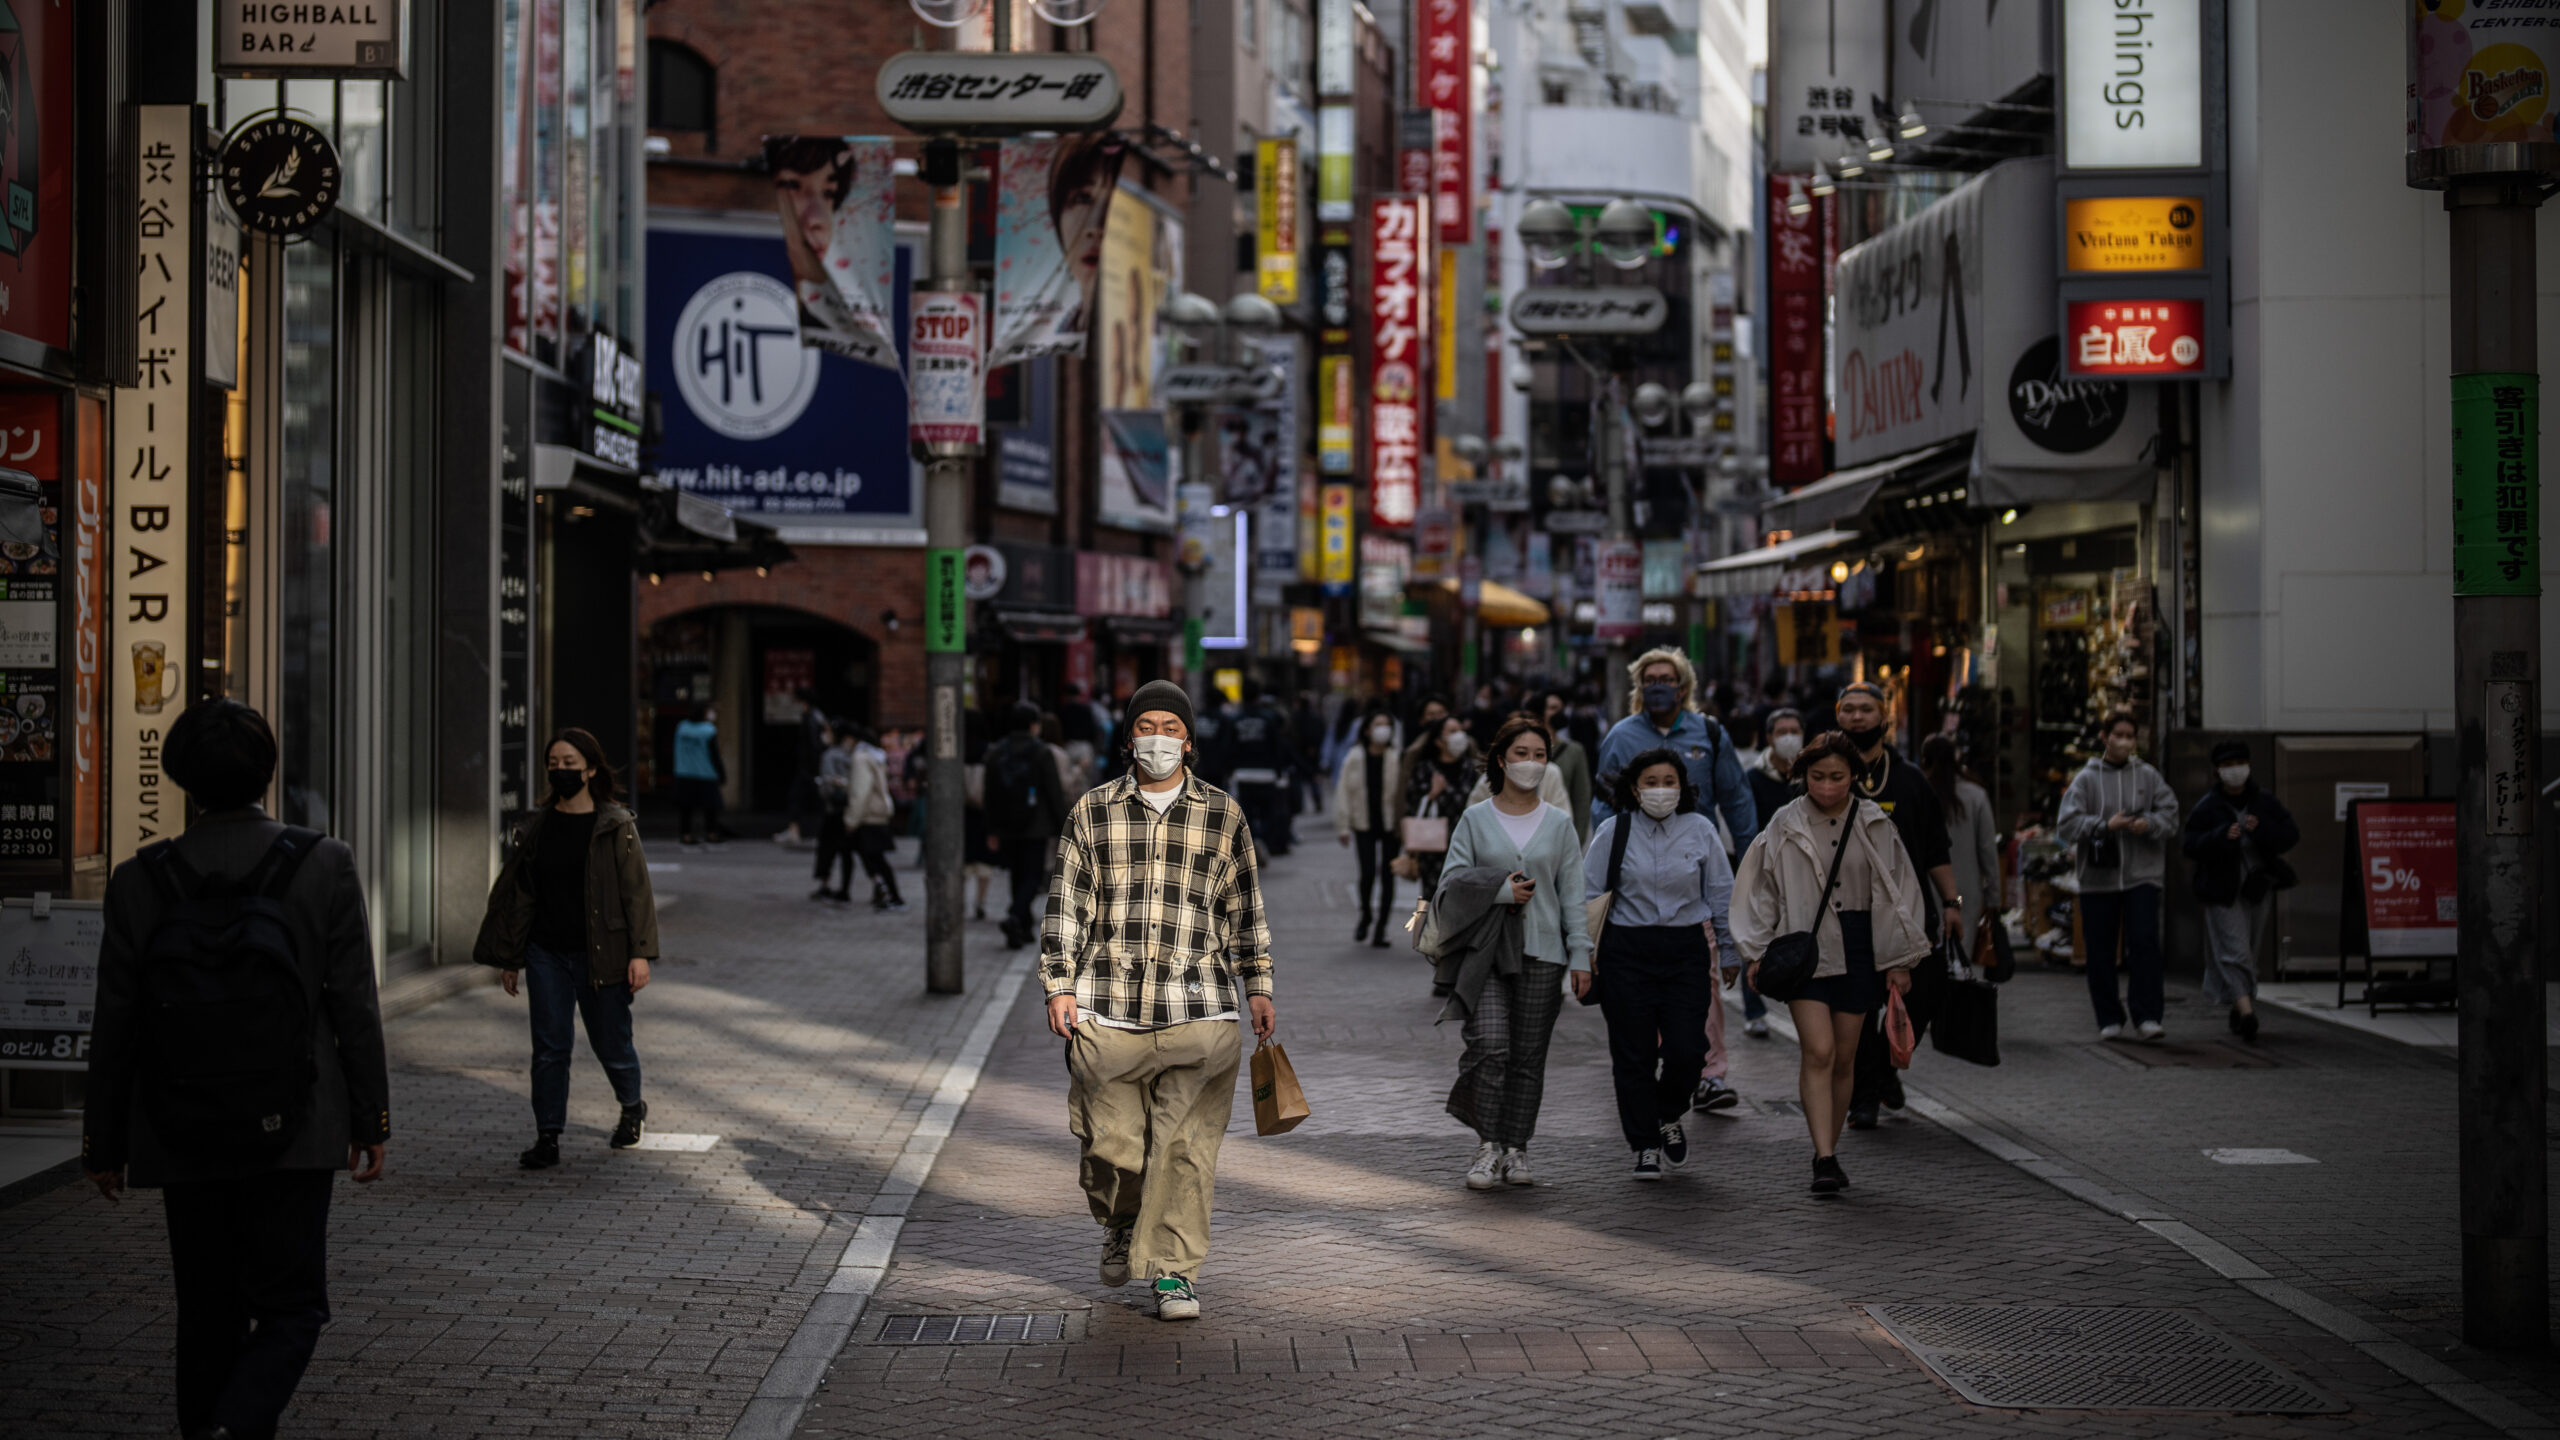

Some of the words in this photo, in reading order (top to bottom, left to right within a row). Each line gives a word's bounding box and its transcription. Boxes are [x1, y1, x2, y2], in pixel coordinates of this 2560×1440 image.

[242, 4, 377, 23] HIGHBALL
[241, 32, 294, 52] BAR
[889, 72, 1105, 101] 渋谷センター街
[240, 122, 323, 155] SHIBUYA
[228, 166, 248, 207] BAR
[256, 166, 334, 229] HIGHBALL
[2144, 230, 2193, 252] Tokyo
[208, 249, 236, 294] BEER
[1375, 201, 1416, 360] カラオケ
[915, 315, 970, 339] STOP
[1843, 347, 1924, 441] DAIWA
[657, 463, 863, 498] ww.hit-ad.co.jp
[2493, 386, 2528, 581] 客引きは犯罪です
[127, 505, 169, 624] BAR
[2512, 714, 2526, 804] バスケットボール
[2496, 771, 2508, 827] ストリート
[2, 827, 53, 840] 23:00
[2371, 855, 2421, 892] 5%
[2, 1041, 47, 1057] のビル
